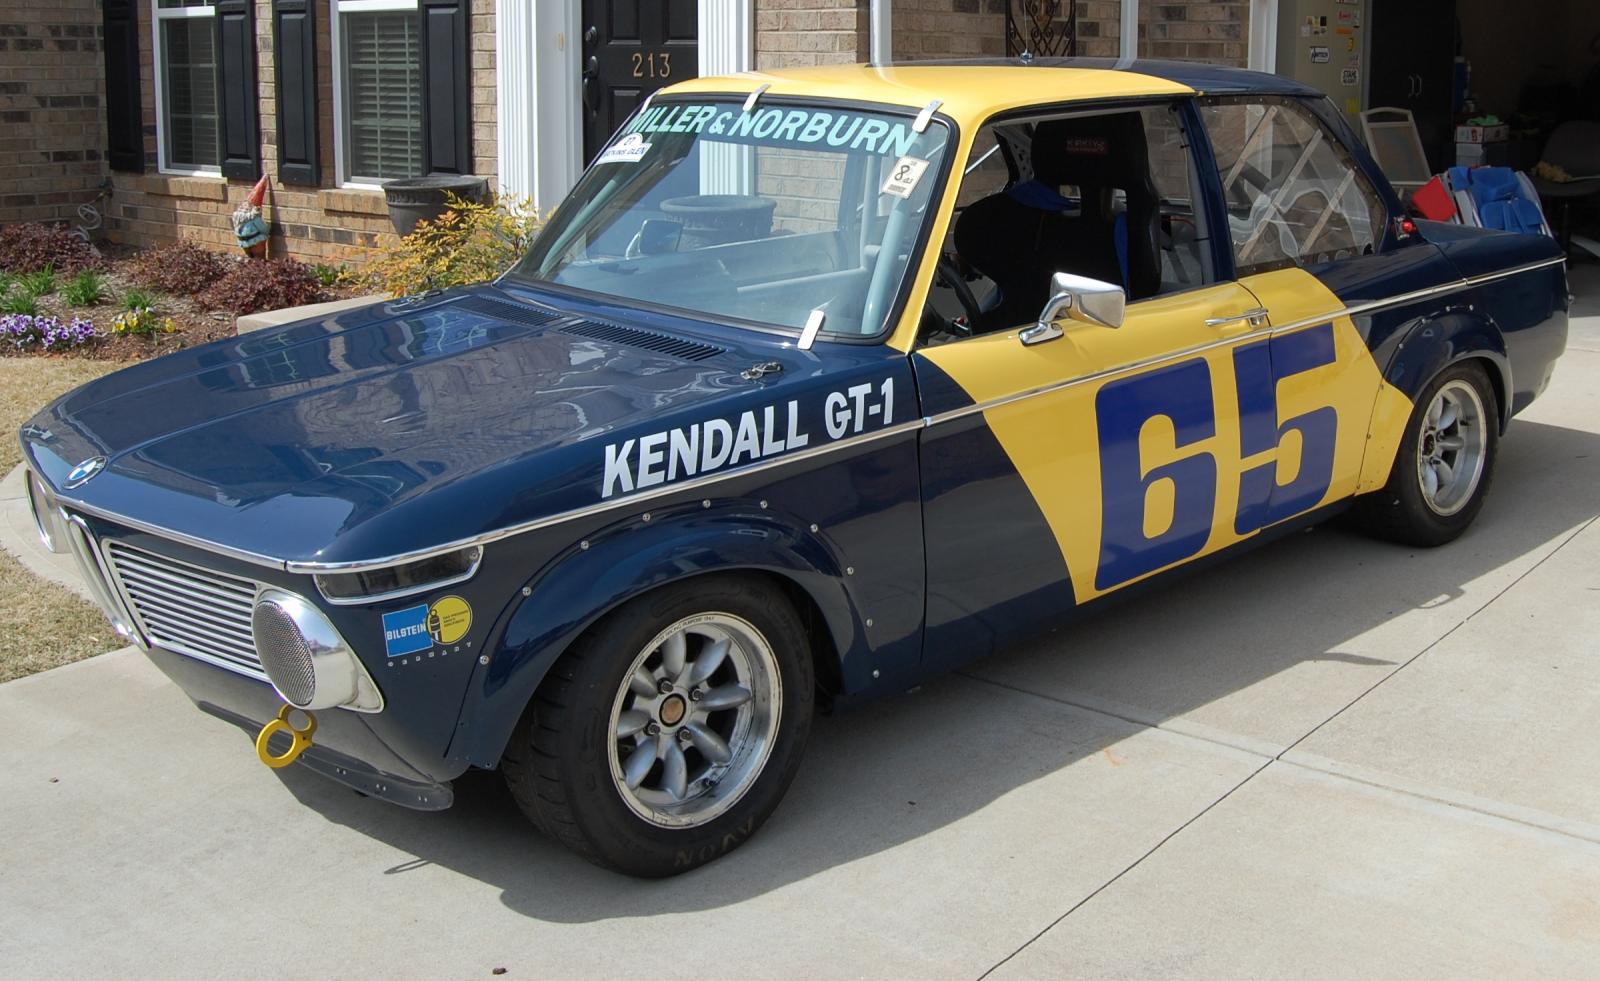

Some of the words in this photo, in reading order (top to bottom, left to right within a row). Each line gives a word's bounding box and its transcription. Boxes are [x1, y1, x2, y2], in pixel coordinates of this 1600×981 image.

[632, 52, 671, 78] 213
[621, 105, 711, 136] MILLER
[729, 107, 918, 158] NORBURN
[894, 164, 911, 181] 8
[602, 400, 809, 498] KENDALL
[824, 377, 894, 440] GT-1
[1094, 321, 1338, 592] 65
[386, 623, 427, 641] BILSTEIN
